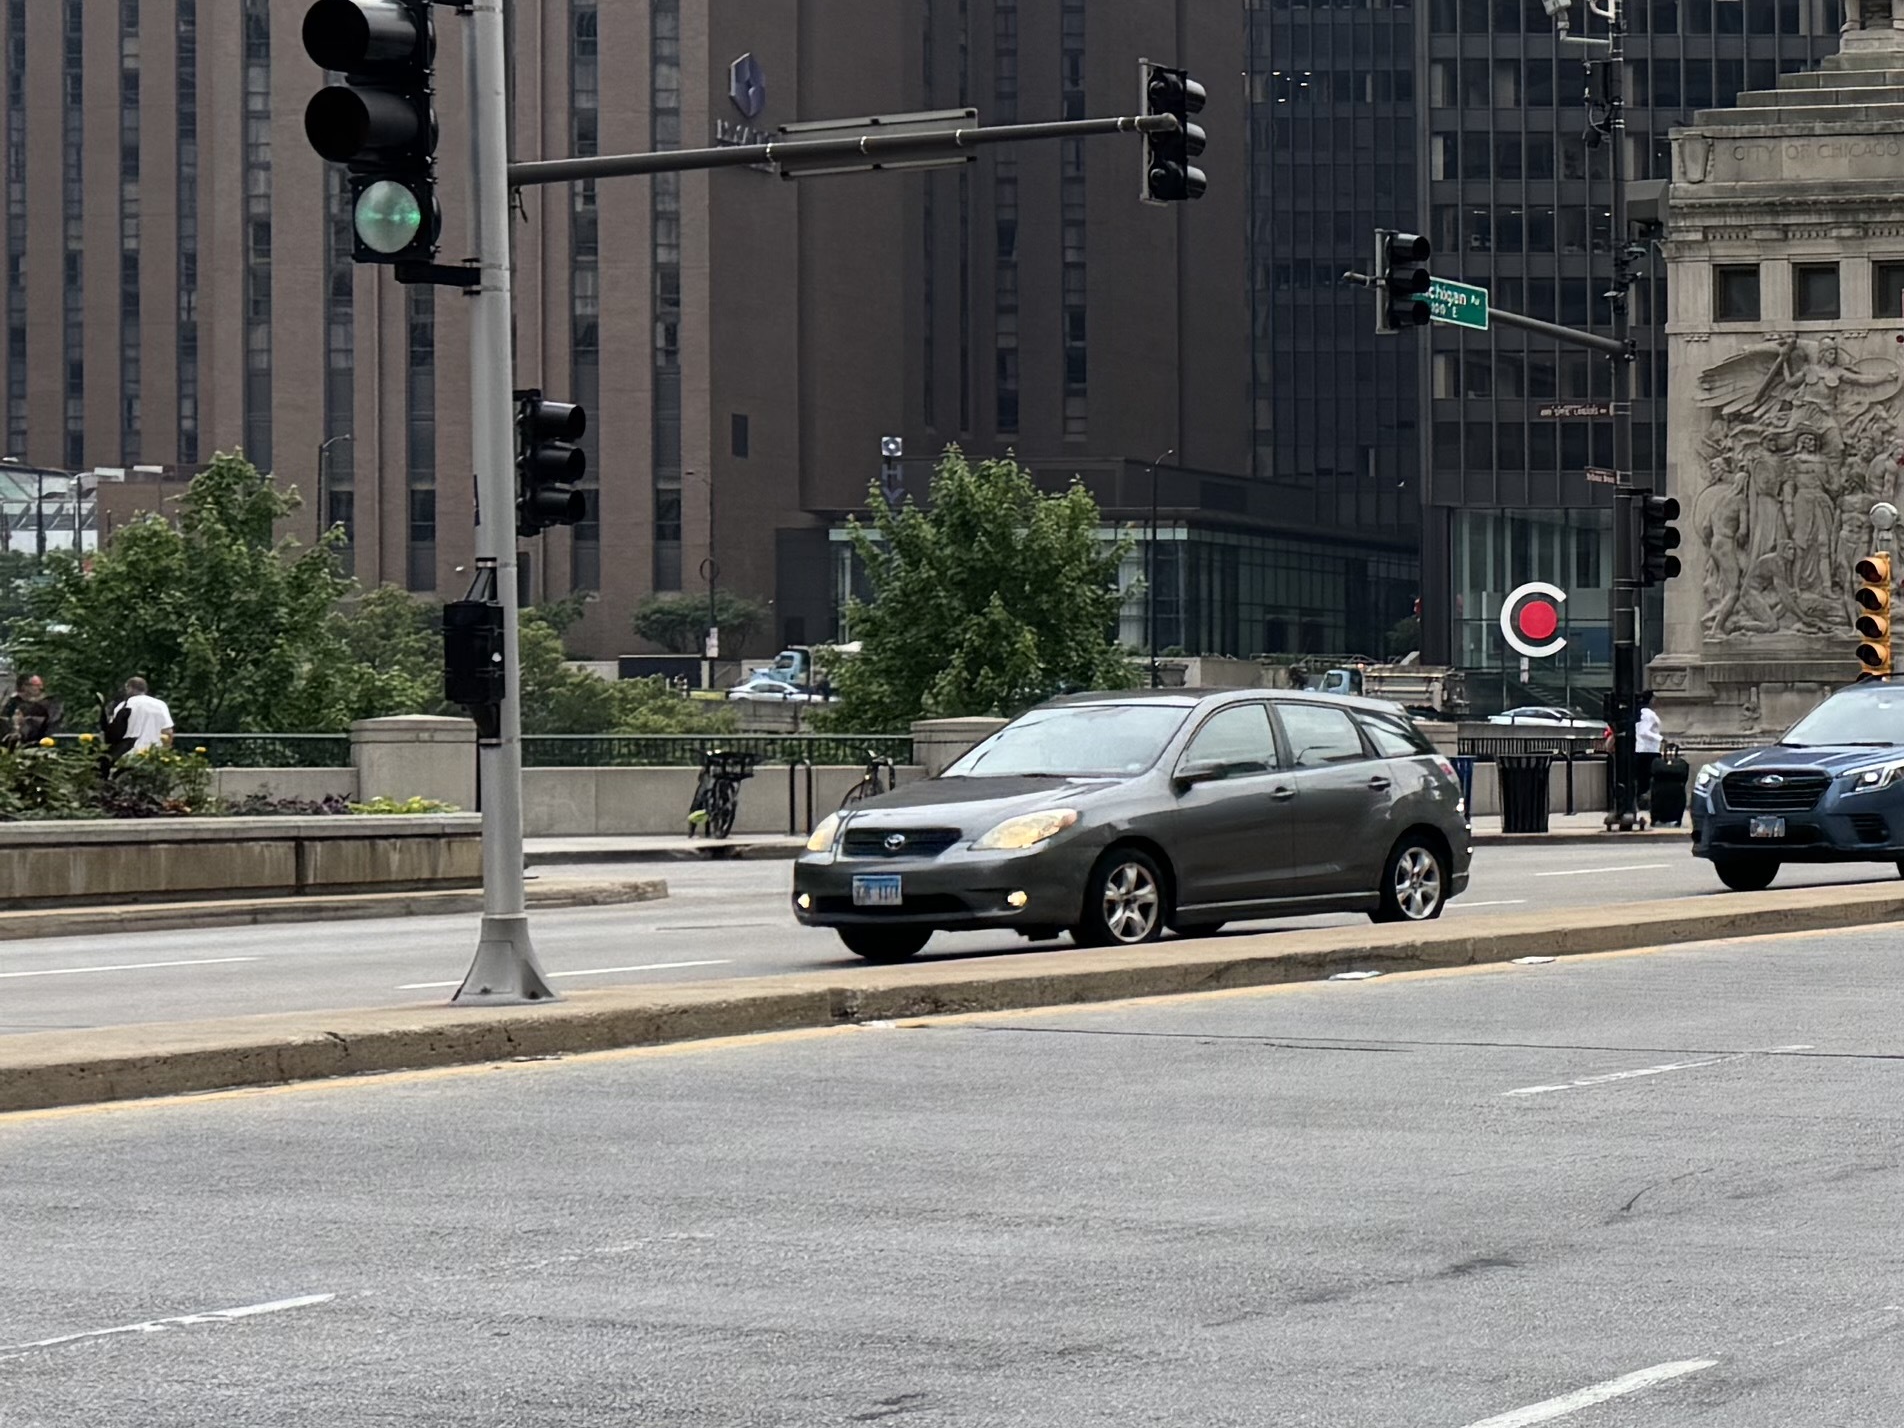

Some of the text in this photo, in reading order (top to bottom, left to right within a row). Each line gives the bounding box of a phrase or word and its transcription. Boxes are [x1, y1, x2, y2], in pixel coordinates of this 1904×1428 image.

[1732, 141, 1901, 162] CITY OF CHICAGO
